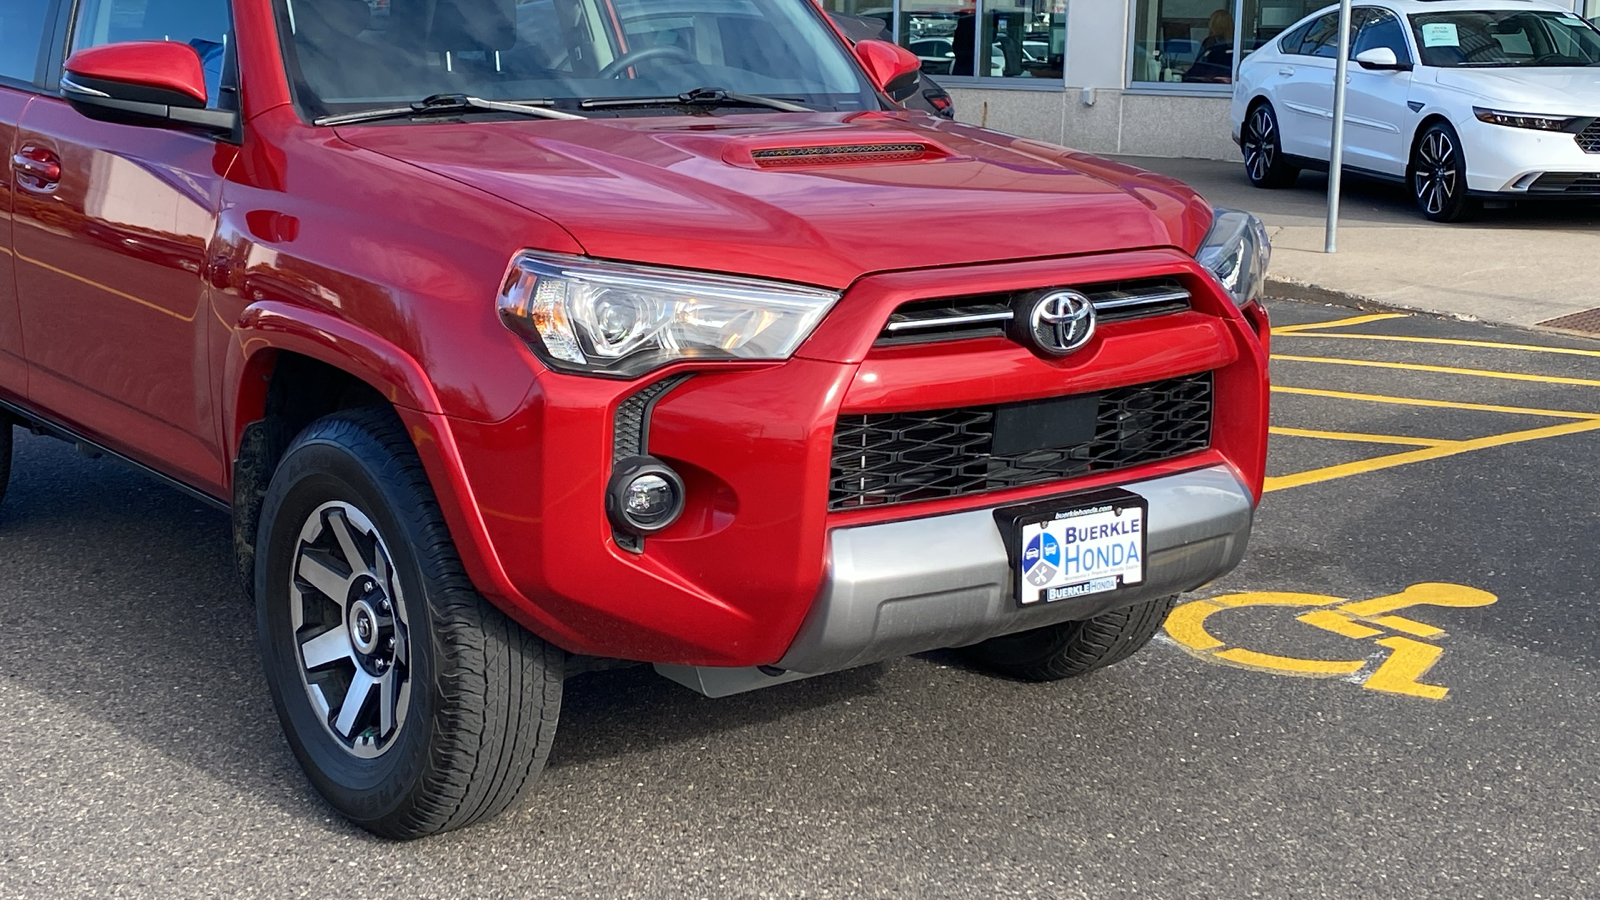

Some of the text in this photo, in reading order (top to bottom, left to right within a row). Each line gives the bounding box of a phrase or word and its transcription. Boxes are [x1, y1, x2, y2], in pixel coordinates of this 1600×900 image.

[1065, 519, 1140, 544] BUERKLE
[1065, 541, 1140, 575] HONDA
[1049, 582, 1090, 600] BUERKLE
